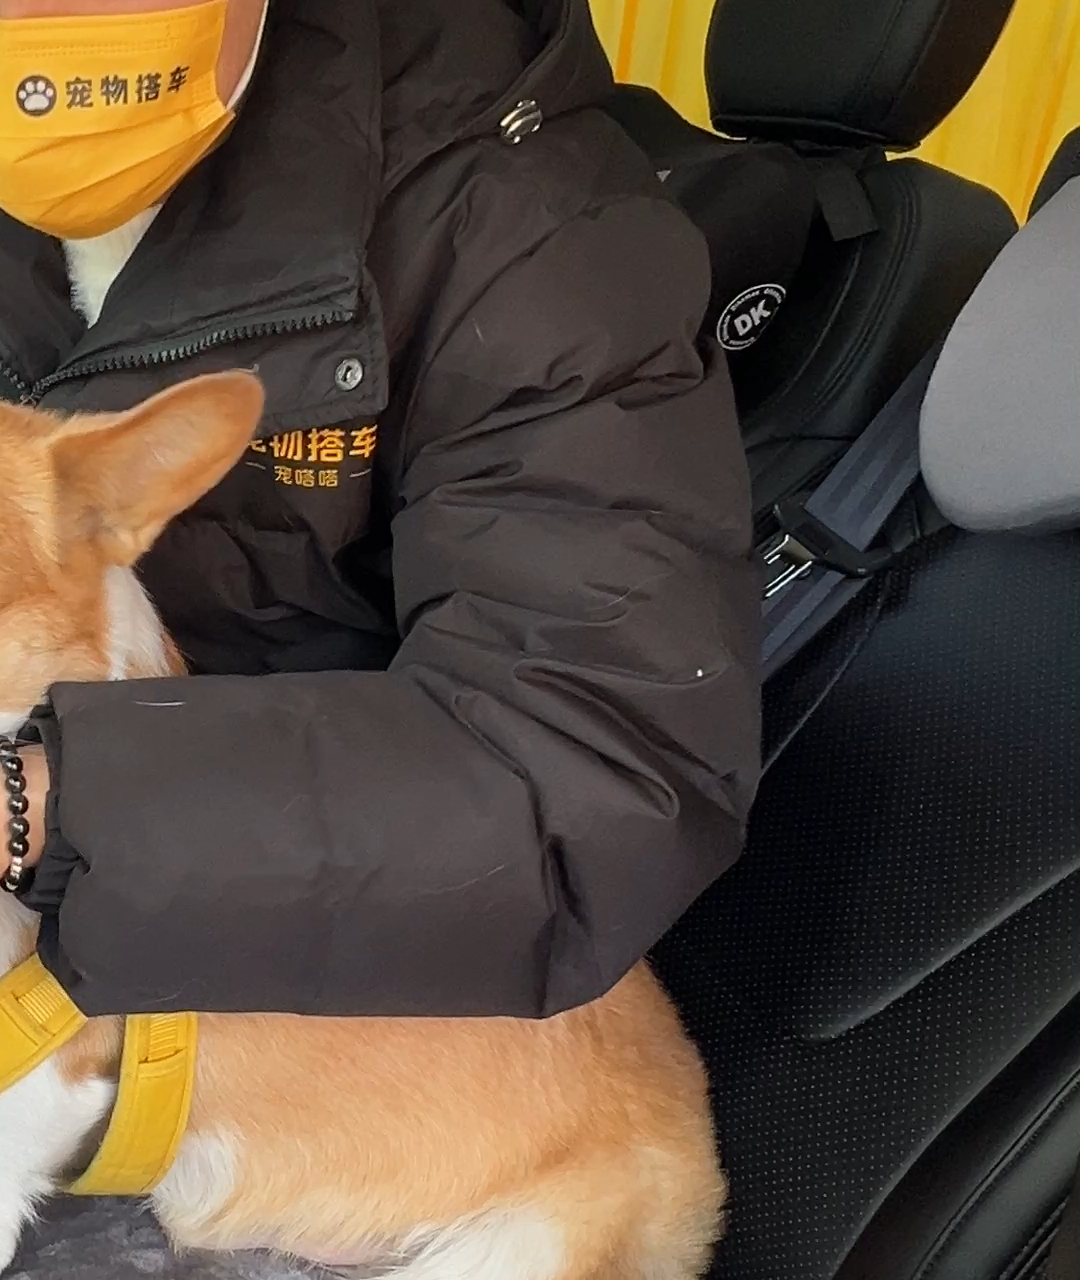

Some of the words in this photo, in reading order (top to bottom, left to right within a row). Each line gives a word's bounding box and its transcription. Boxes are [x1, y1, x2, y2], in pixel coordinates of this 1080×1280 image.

[65, 64, 190, 110] 宠物搭车
[733, 299, 771, 337] DK
[248, 424, 378, 463] 物搭车
